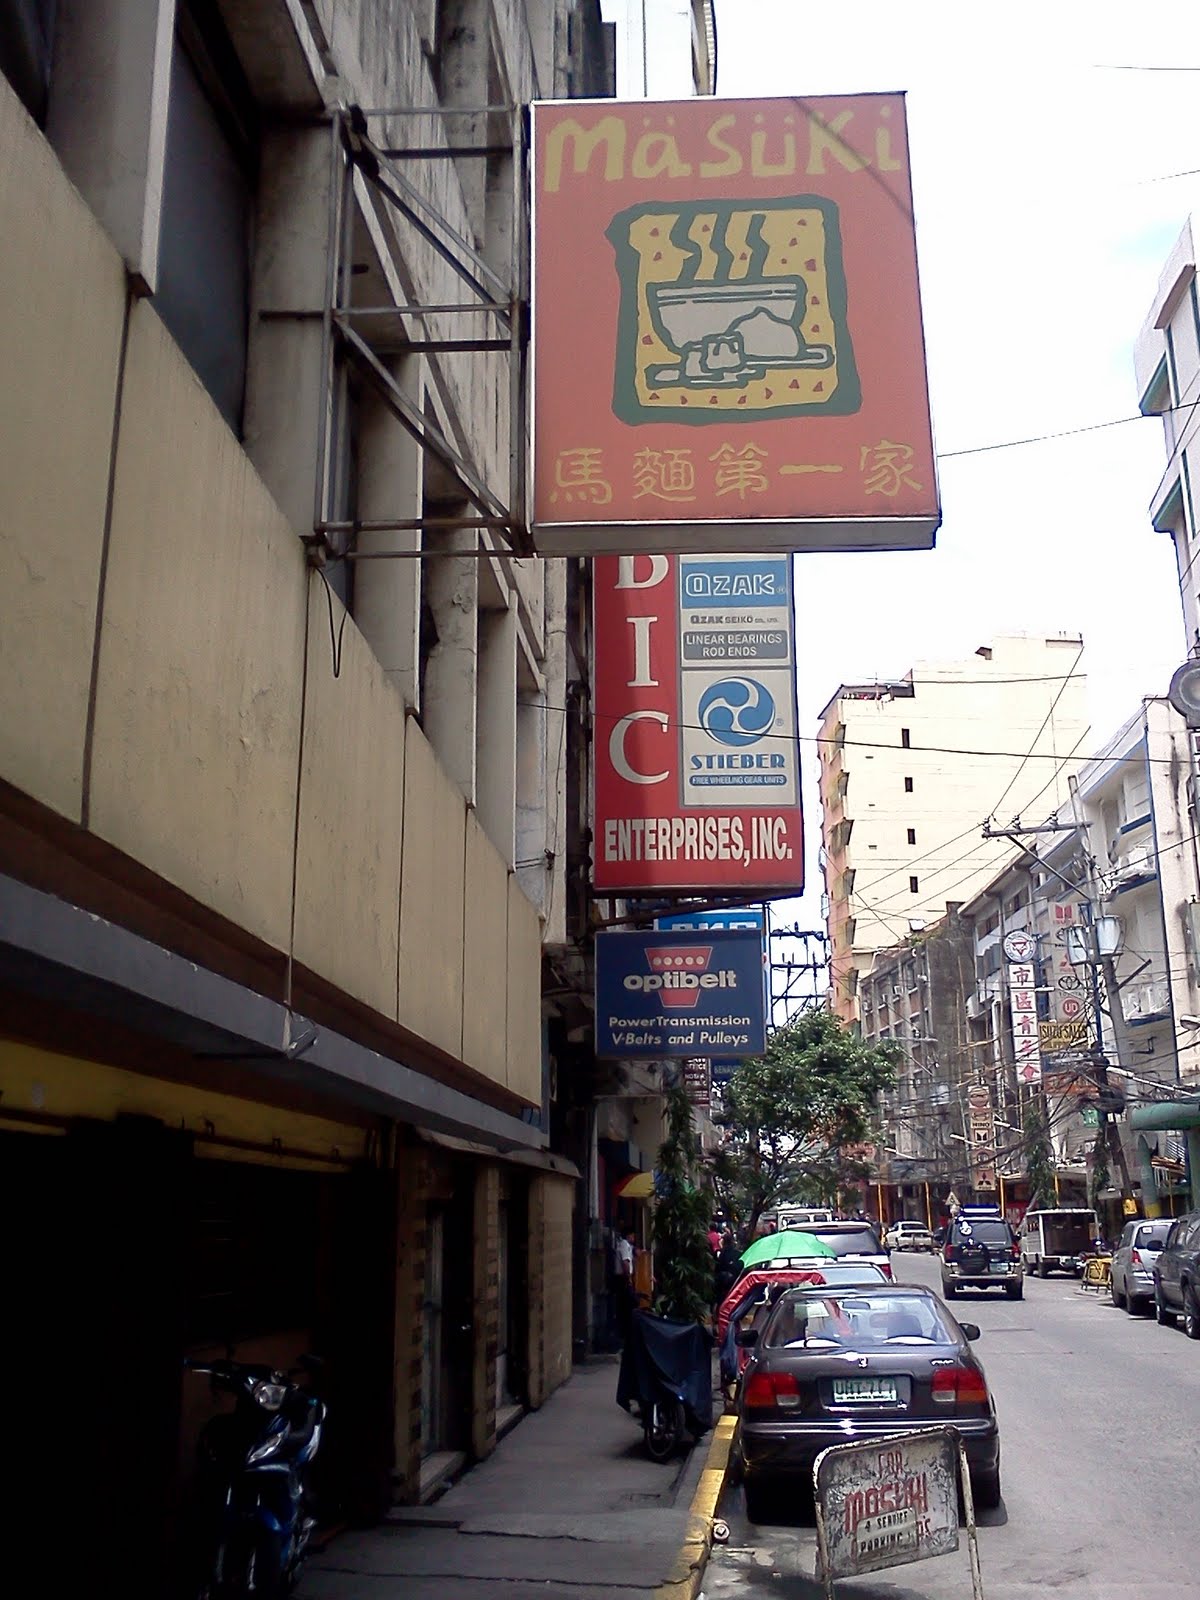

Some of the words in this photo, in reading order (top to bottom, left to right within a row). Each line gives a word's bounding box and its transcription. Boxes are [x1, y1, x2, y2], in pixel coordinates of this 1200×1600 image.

[550, 440, 922, 505] 馬麵第一家
[685, 573, 775, 597] OZAK
[690, 615, 723, 624] OZAK
[724, 616, 753, 624] SEIKO
[686, 635, 725, 645] LINEAR
[727, 634, 782, 644] BEARINGS
[702, 647, 725, 657] ROD
[728, 646, 757, 657] ENDS
[690, 754, 786, 770] STIEBER
[692, 776, 709, 784] FREE
[710, 776, 743, 784] WHEELING
[744, 776, 762, 784] GEAR
[764, 775, 784, 783] UNITS
[623, 970, 737, 992] optibelt
[1064, 1002, 1078, 1012] UD
[668, 1032, 694, 1044] and
[700, 1031, 748, 1046] Pulleys
